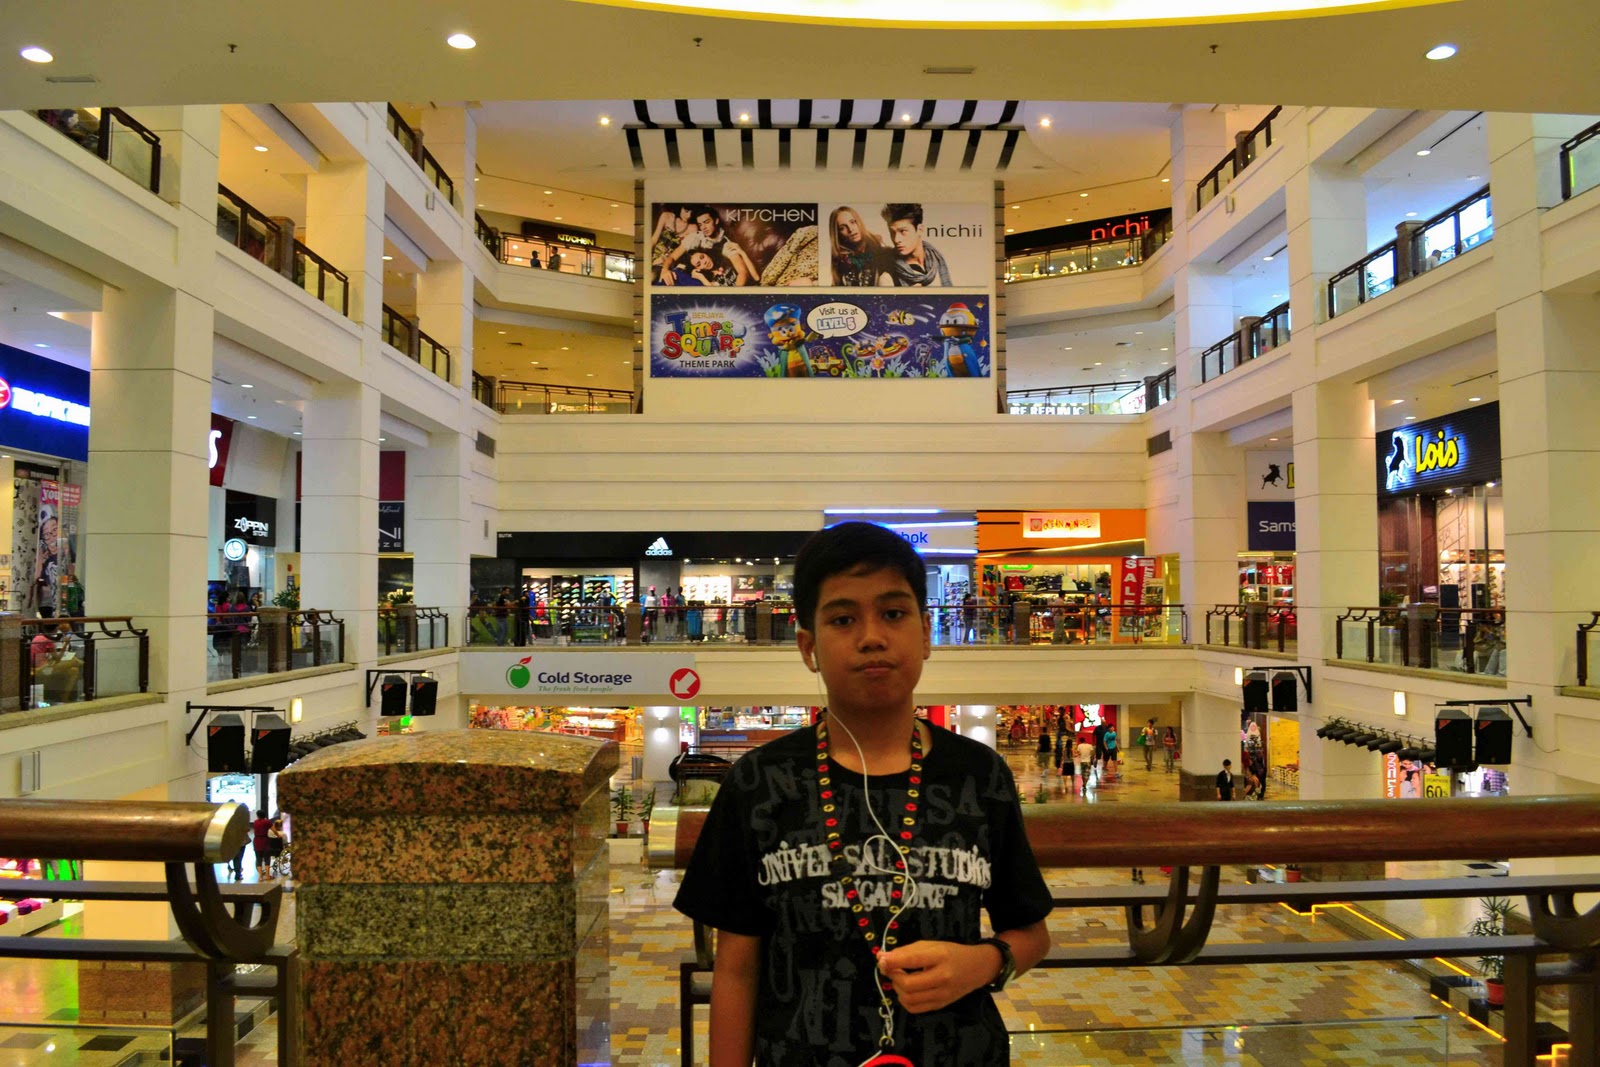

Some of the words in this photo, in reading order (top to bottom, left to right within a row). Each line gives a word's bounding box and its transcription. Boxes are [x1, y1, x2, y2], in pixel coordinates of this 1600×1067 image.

[926, 224, 982, 238] nichii
[1091, 216, 1149, 241] nichii
[818, 307, 836, 316] Visit
[838, 308, 849, 316] us
[817, 317, 846, 331] LEVEL
[846, 317, 856, 331] 5
[680, 360, 710, 368] THEME
[712, 360, 736, 368] PARK
[1415, 429, 1459, 474] Lois
[1258, 520, 1296, 533] Sams
[902, 531, 928, 544] bok
[1123, 559, 1138, 610] SALE
[538, 672, 570, 684] Cold
[573, 672, 633, 686] Storage
